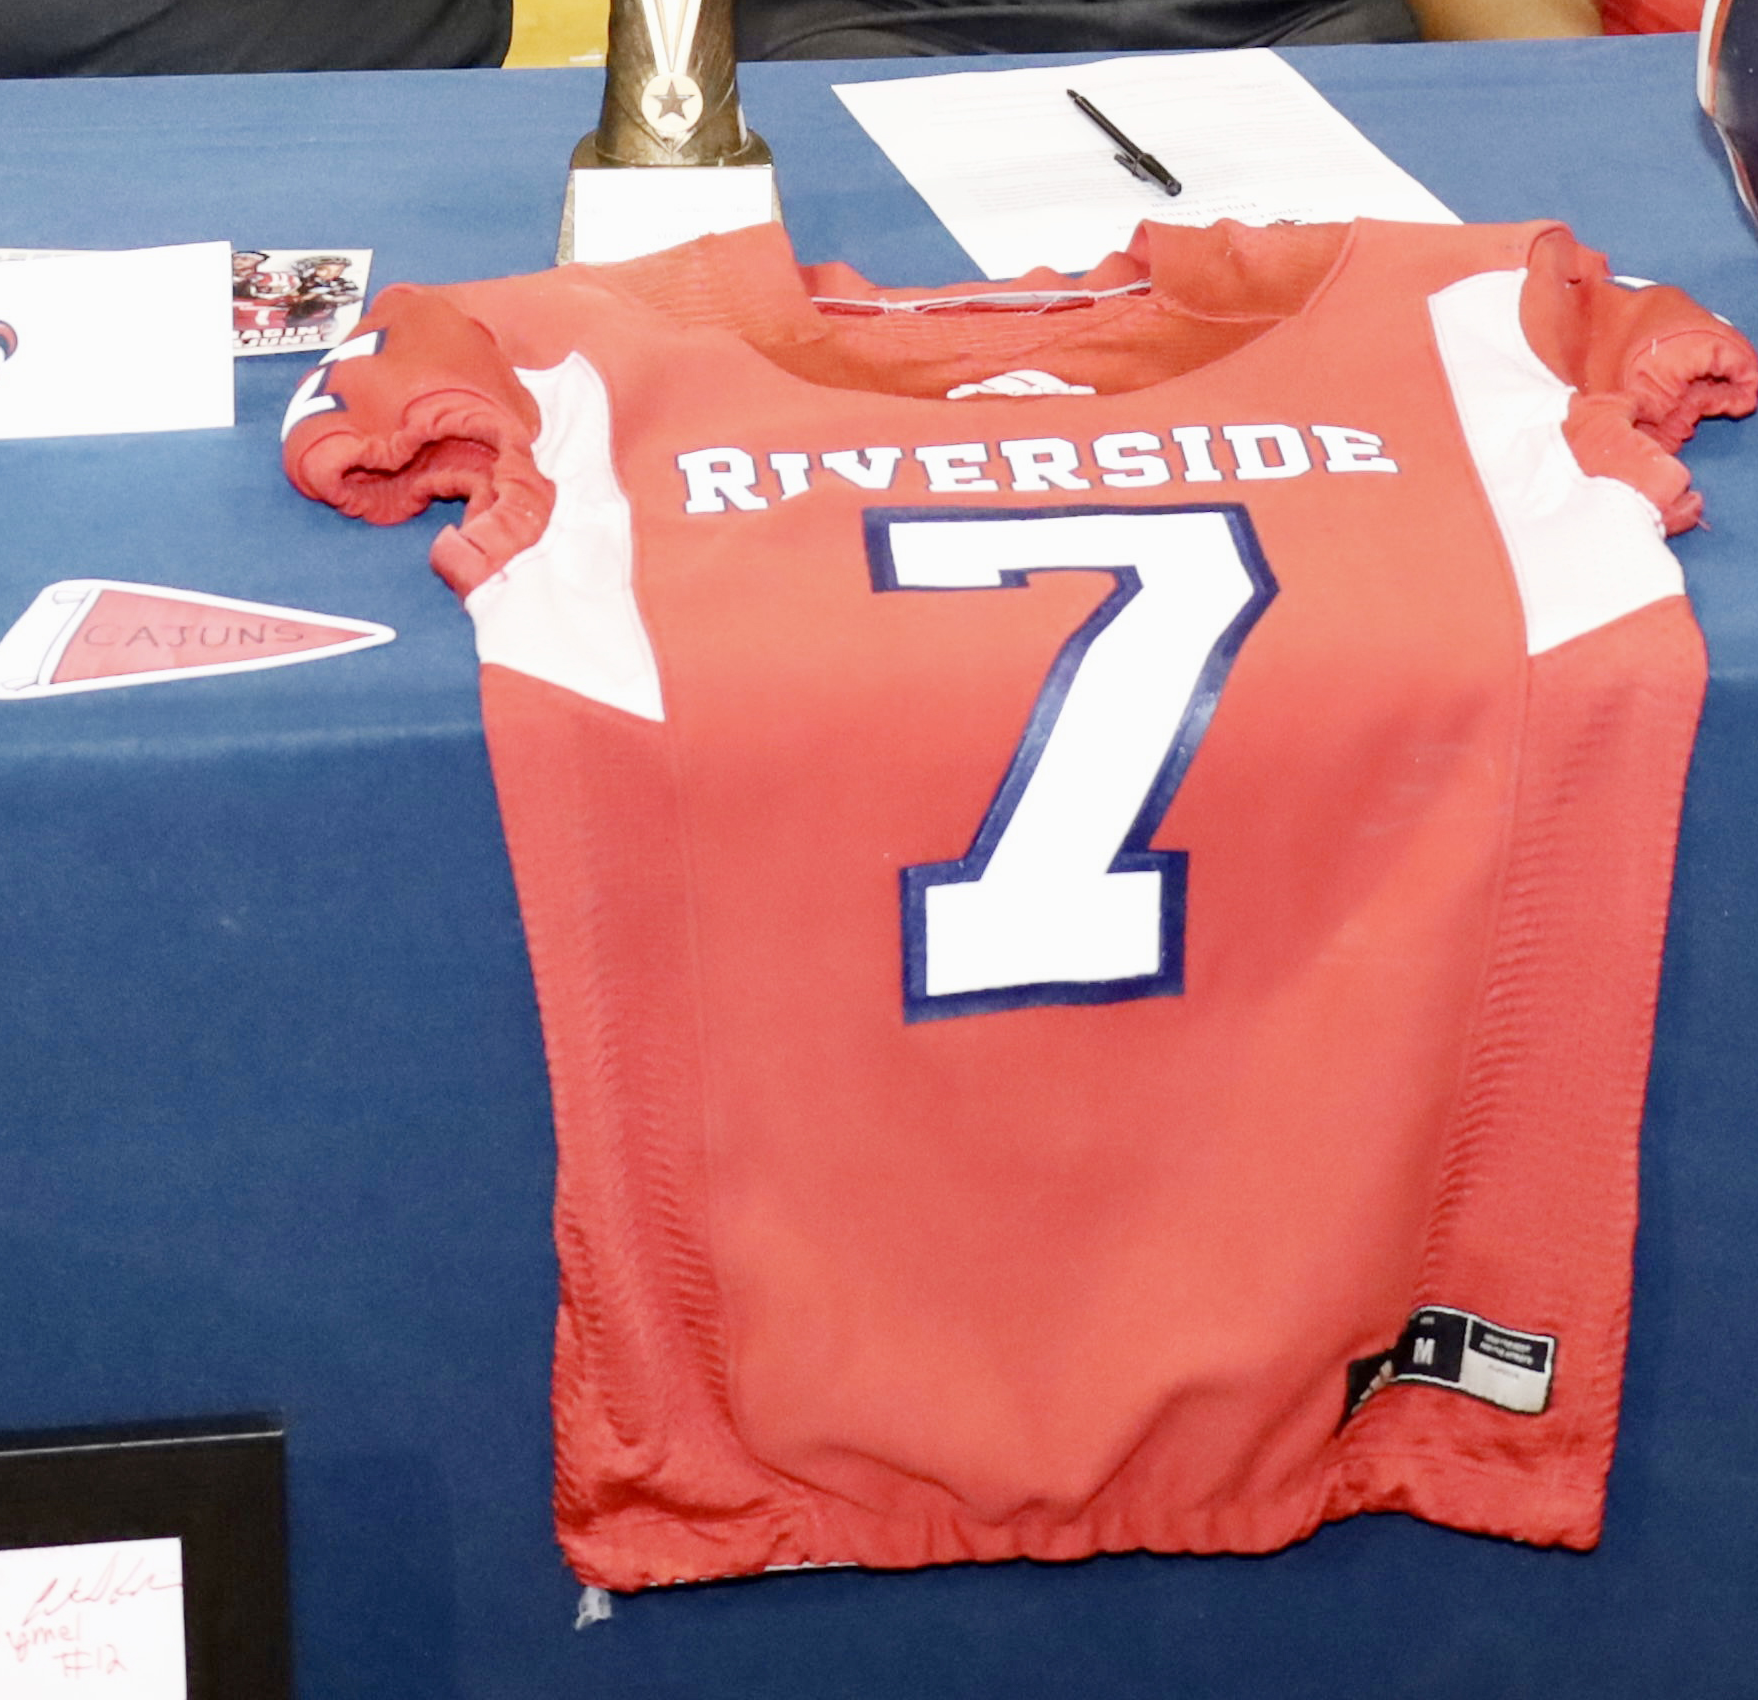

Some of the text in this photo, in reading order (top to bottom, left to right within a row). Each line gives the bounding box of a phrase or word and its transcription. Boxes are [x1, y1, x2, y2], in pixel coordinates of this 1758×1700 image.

[675, 423, 1400, 515] RIVERSIDE
[84, 623, 304, 648] CAJUNS
[862, 503, 1280, 1025] 7
[1413, 1337, 1436, 1365] M
